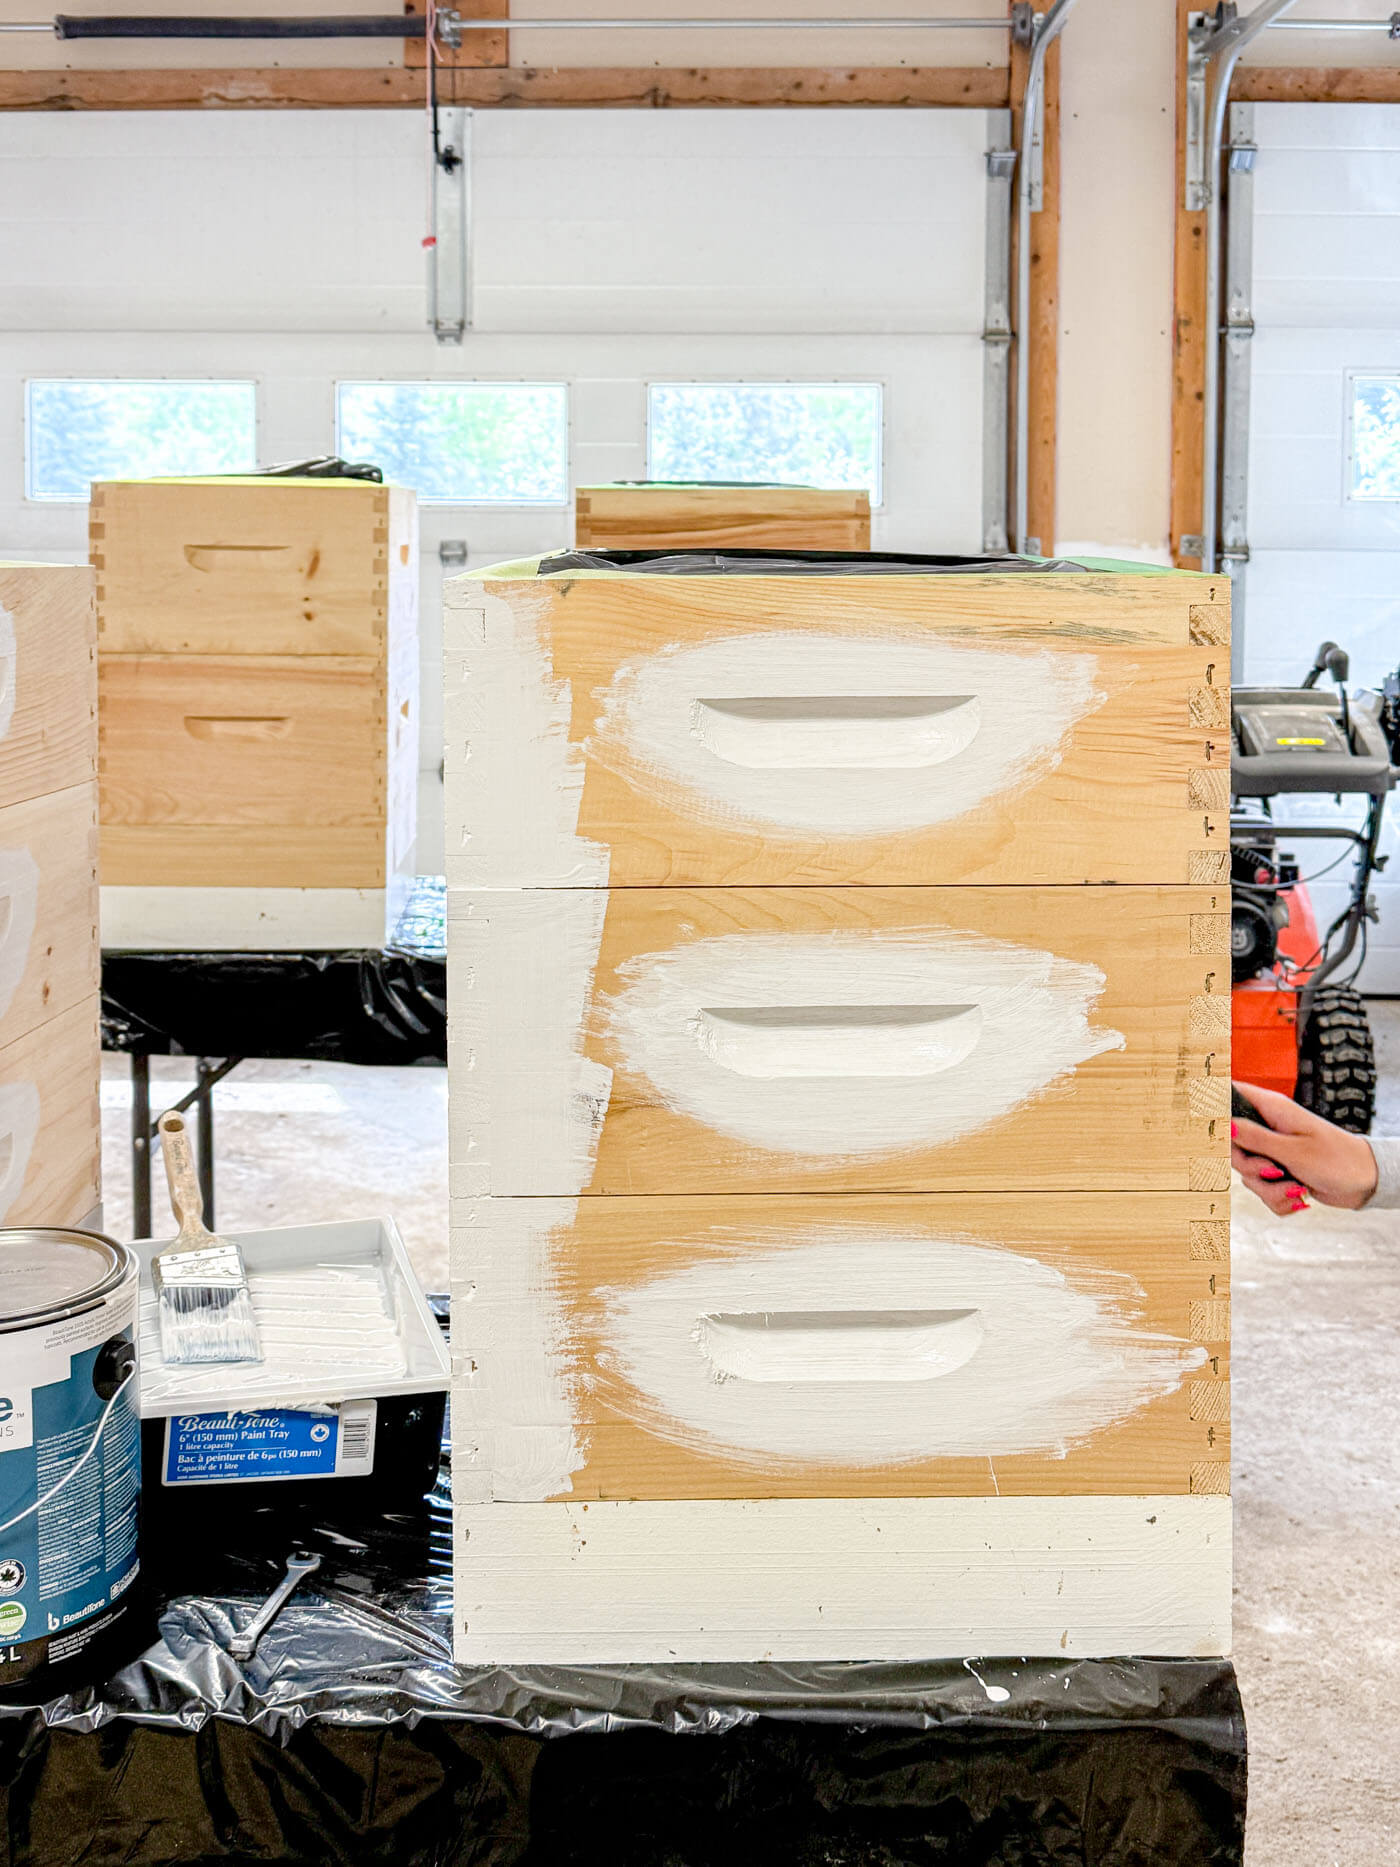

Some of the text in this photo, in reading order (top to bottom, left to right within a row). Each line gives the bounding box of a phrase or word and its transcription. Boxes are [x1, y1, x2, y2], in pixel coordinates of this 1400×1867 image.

[193, 1432, 212, 1443] (150
[215, 1431, 238, 1441] mm)
[241, 1430, 266, 1440] Paint
[269, 1429, 290, 1440] Tray
[203, 1442, 234, 1451] capacity
[178, 1455, 195, 1463] Bac
[198, 1454, 203, 1463] à
[206, 1453, 245, 1465] peinture
[248, 1451, 259, 1460] de
[279, 1449, 299, 1459] (150
[300, 1448, 322, 1458] mm)
[177, 1464, 206, 1473] Capacité
[208, 1463, 217, 1471] de
[62, 1598, 105, 1625] BeautiTone
[9, 1646, 21, 1661] L
